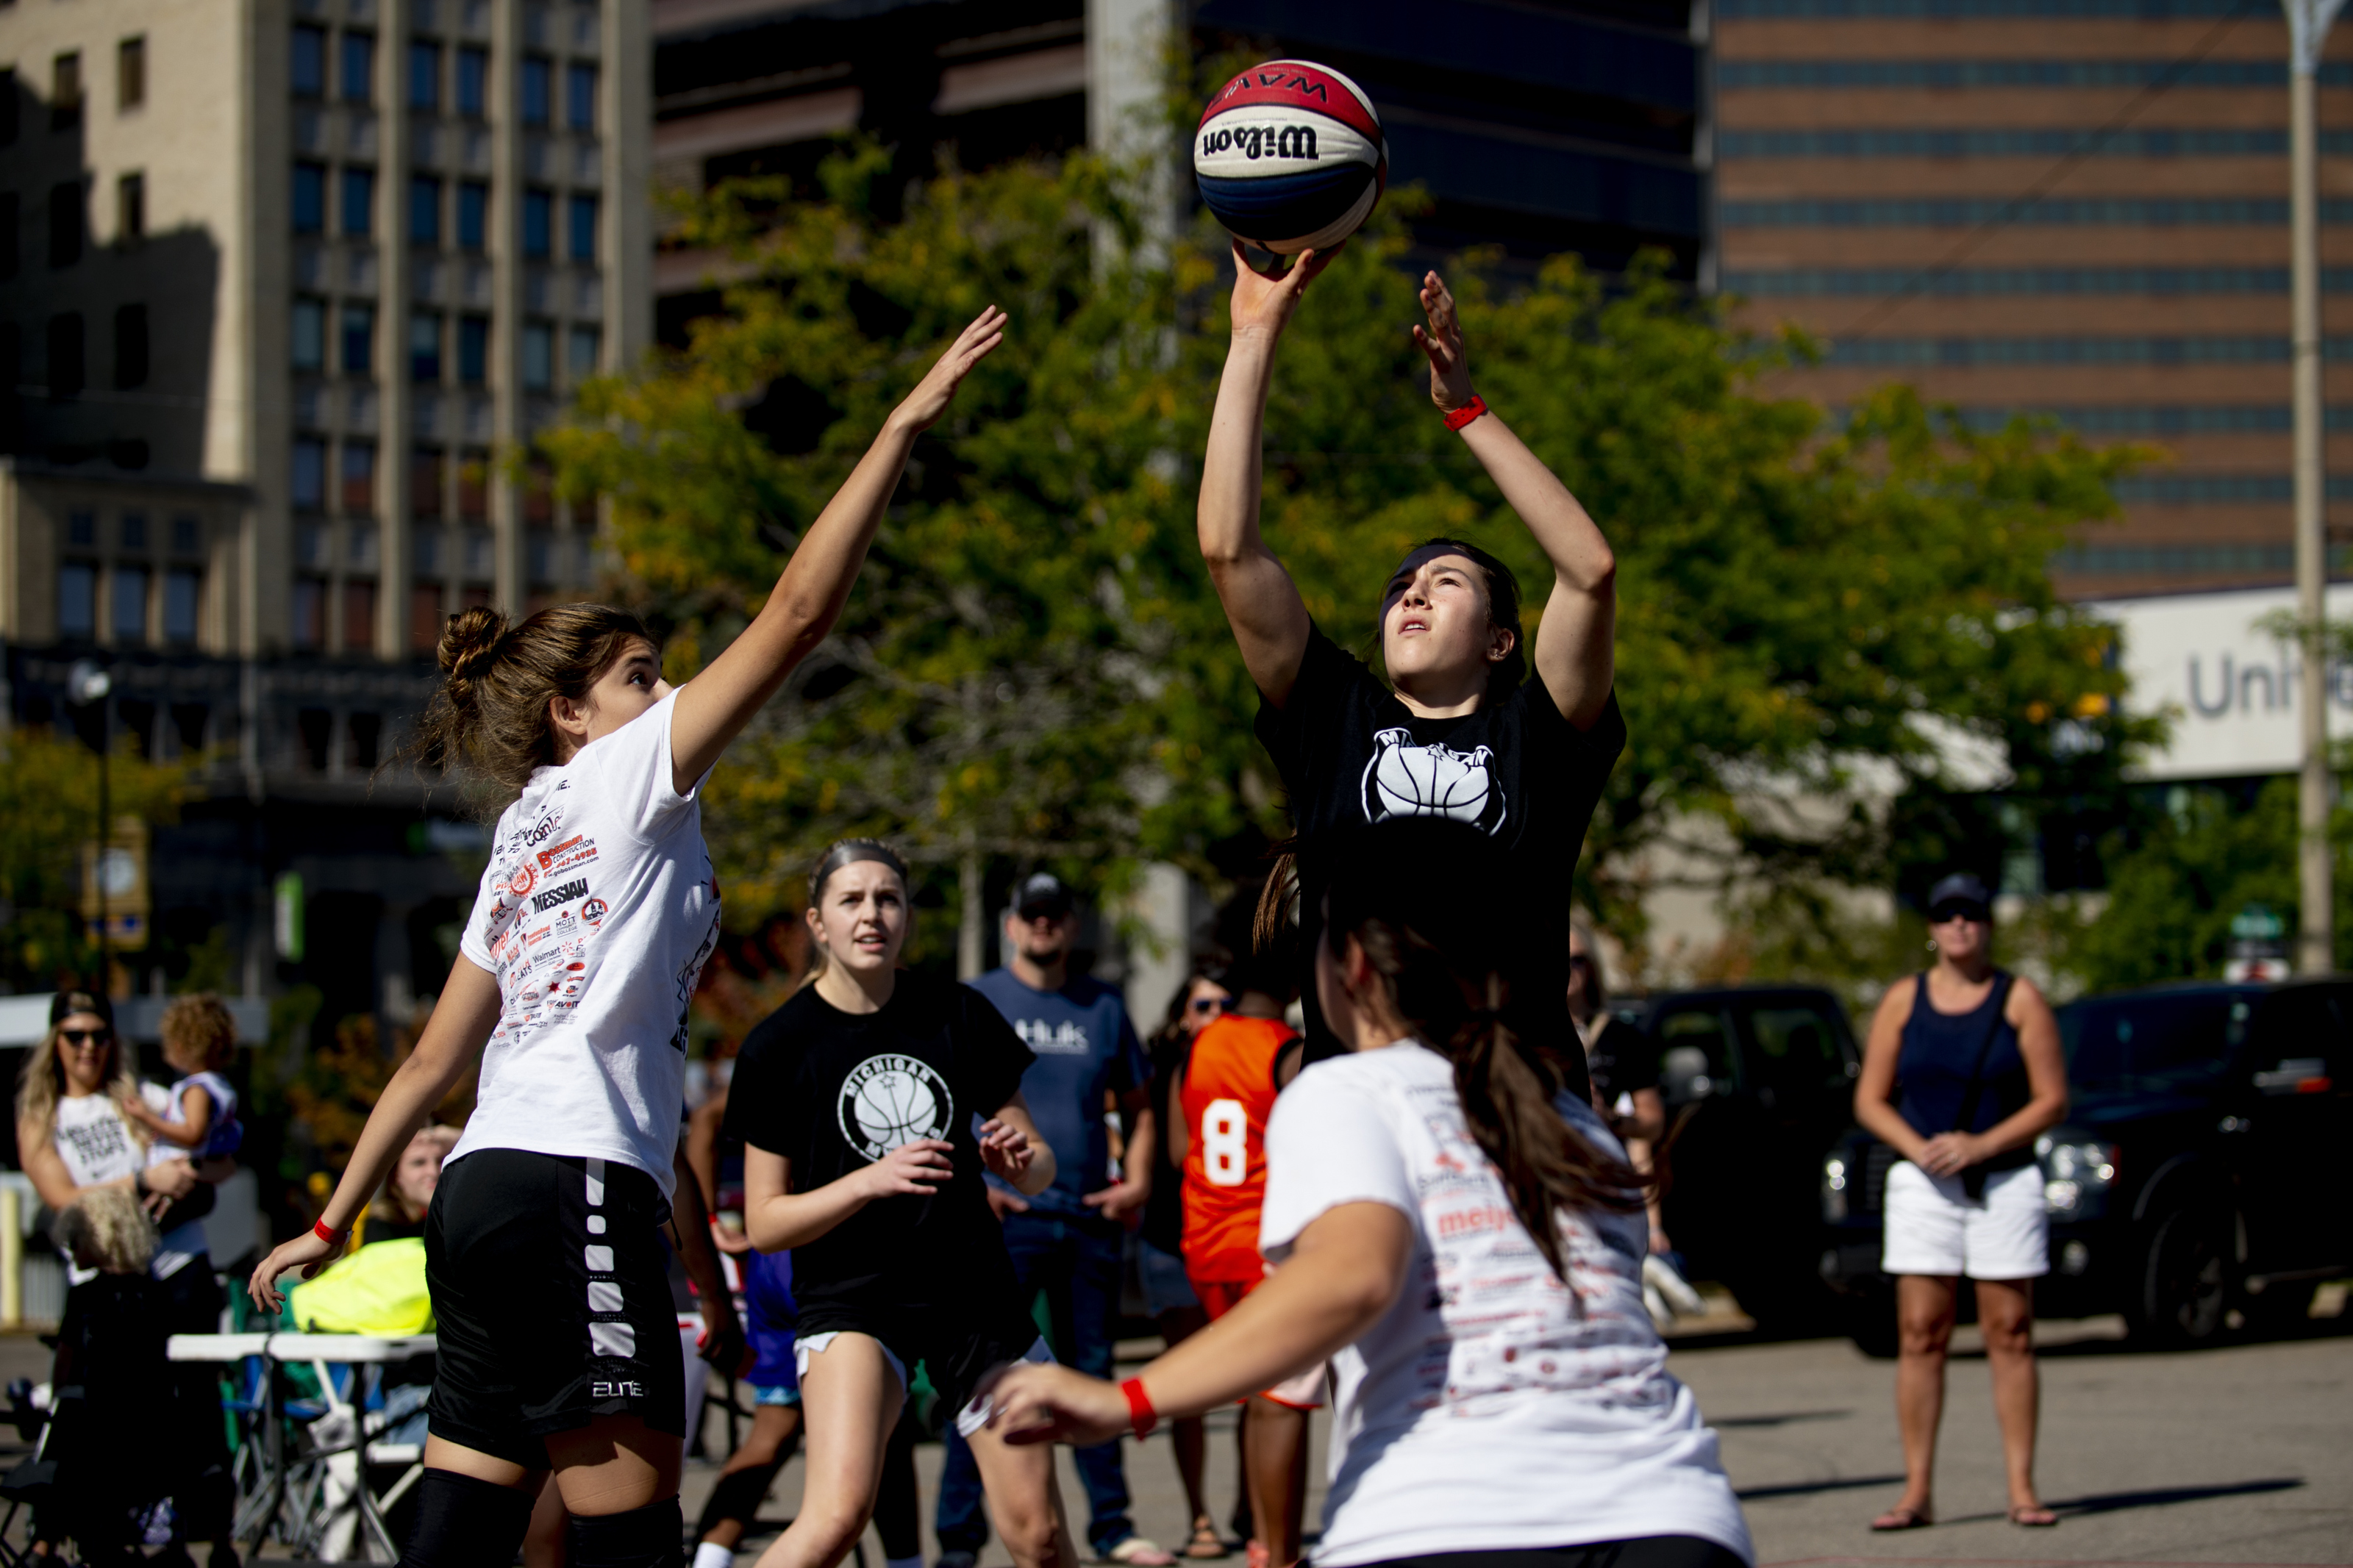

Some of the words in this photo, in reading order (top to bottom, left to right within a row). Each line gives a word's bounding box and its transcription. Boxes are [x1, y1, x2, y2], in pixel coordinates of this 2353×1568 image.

[1203, 125, 1321, 160] Wilson
[536, 834, 583, 870] Bossman
[553, 837, 595, 864] CONSTRUCTION
[513, 871, 528, 887] UAW
[531, 877, 589, 915] MESSIAH
[556, 915, 576, 928] MOTT
[557, 923, 576, 931] COMMUNITY
[557, 926, 578, 936] COLLEGE
[532, 946, 561, 964] Walmart
[1015, 1017, 1089, 1048] Huk
[846, 1057, 932, 1098] MICHIGAN
[1202, 1098, 1247, 1186] 8
[592, 1381, 644, 1397] ELITE
